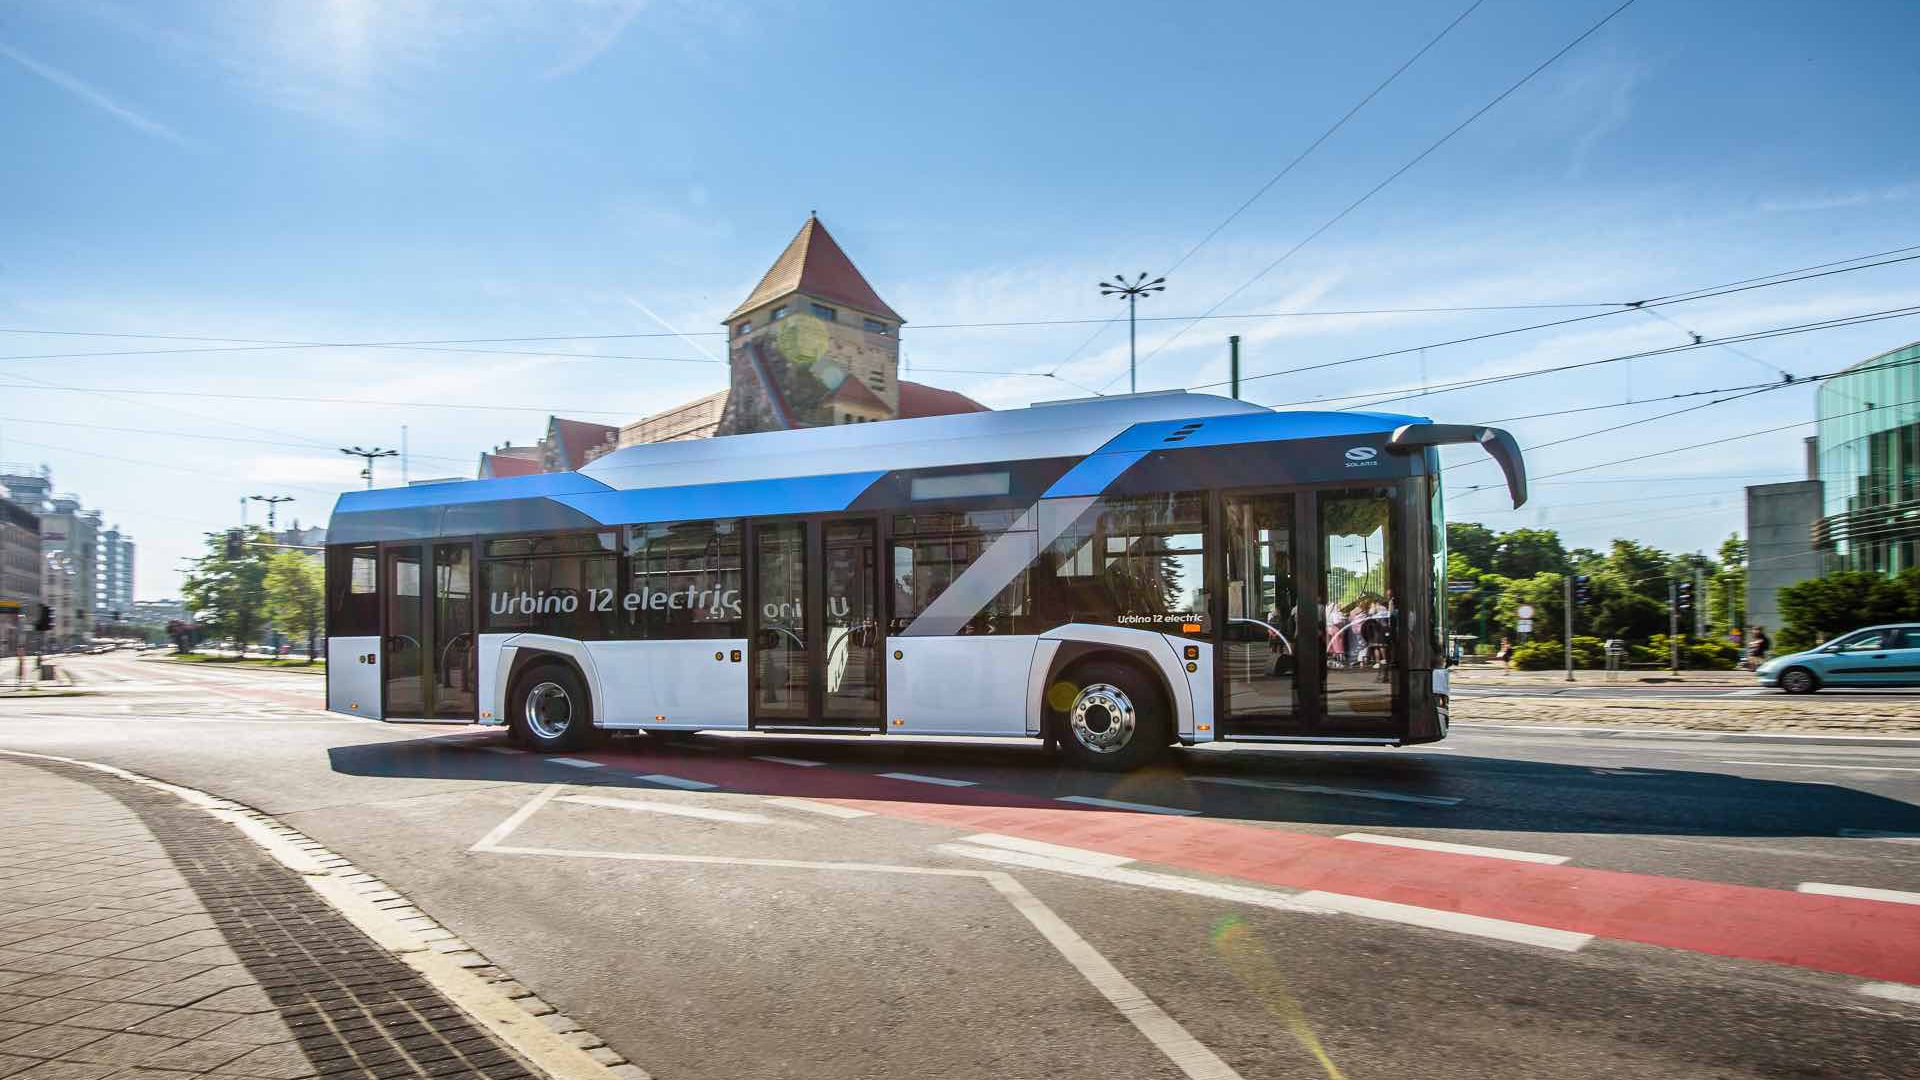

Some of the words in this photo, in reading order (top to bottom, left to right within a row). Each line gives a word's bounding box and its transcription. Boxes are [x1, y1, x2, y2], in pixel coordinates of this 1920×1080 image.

[490, 590, 579, 615] Urbino
[587, 588, 614, 612] 12
[623, 583, 739, 611] electric
[1117, 615, 1151, 624] Urbino
[1152, 614, 1163, 623] 12
[1164, 614, 1204, 622] electric
